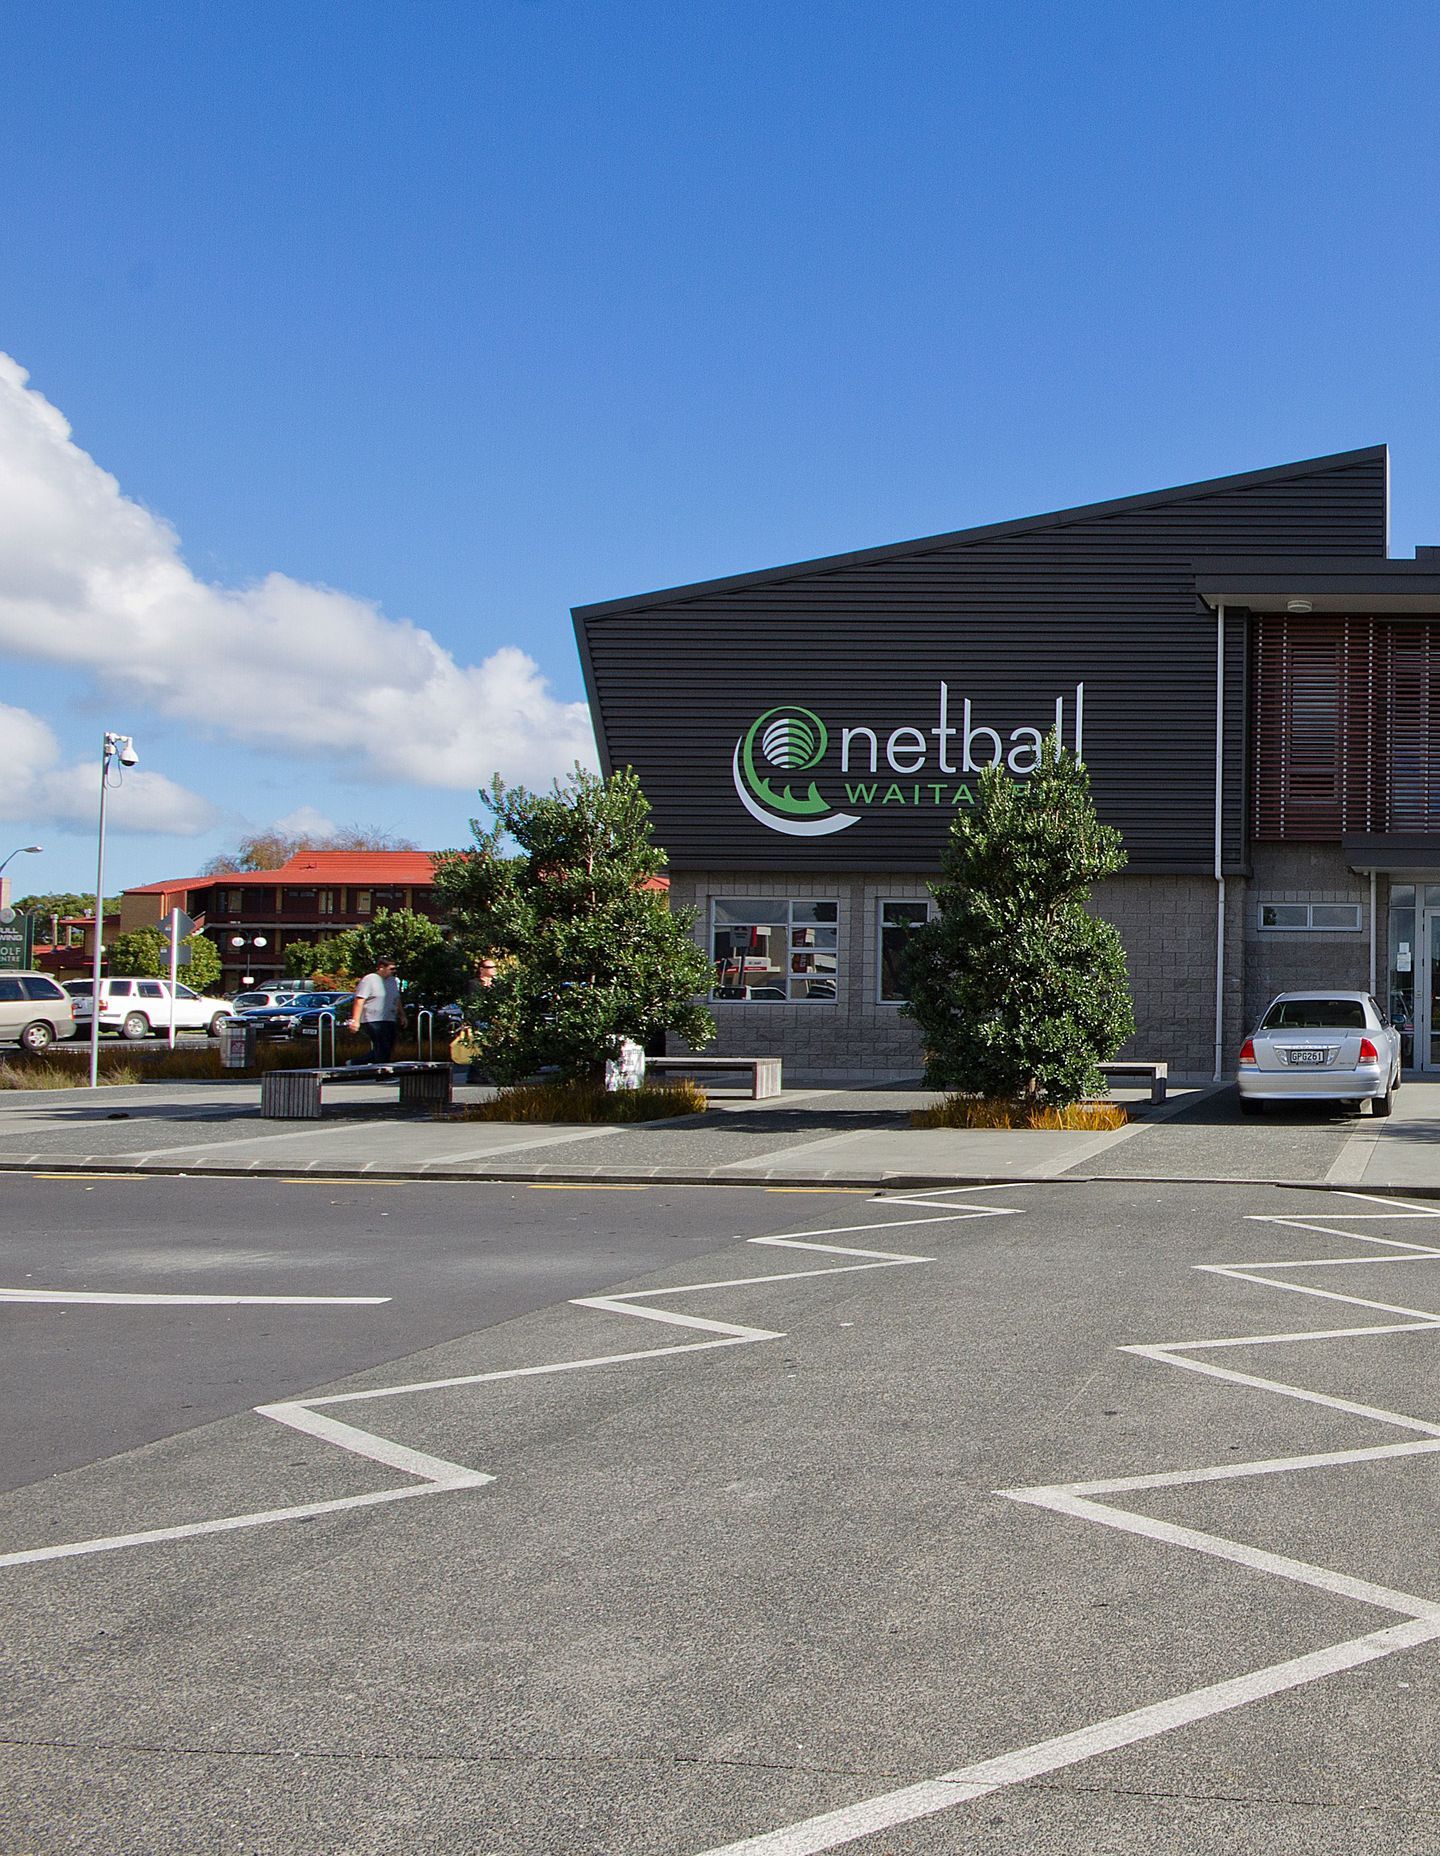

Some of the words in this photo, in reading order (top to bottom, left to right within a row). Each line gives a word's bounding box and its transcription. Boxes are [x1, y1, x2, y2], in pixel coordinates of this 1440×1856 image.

[841, 680, 1084, 774] netball
[0, 934, 23, 942] WING
[0, 947, 21, 956] OLF
[1292, 1052, 1322, 1061] GPG261
